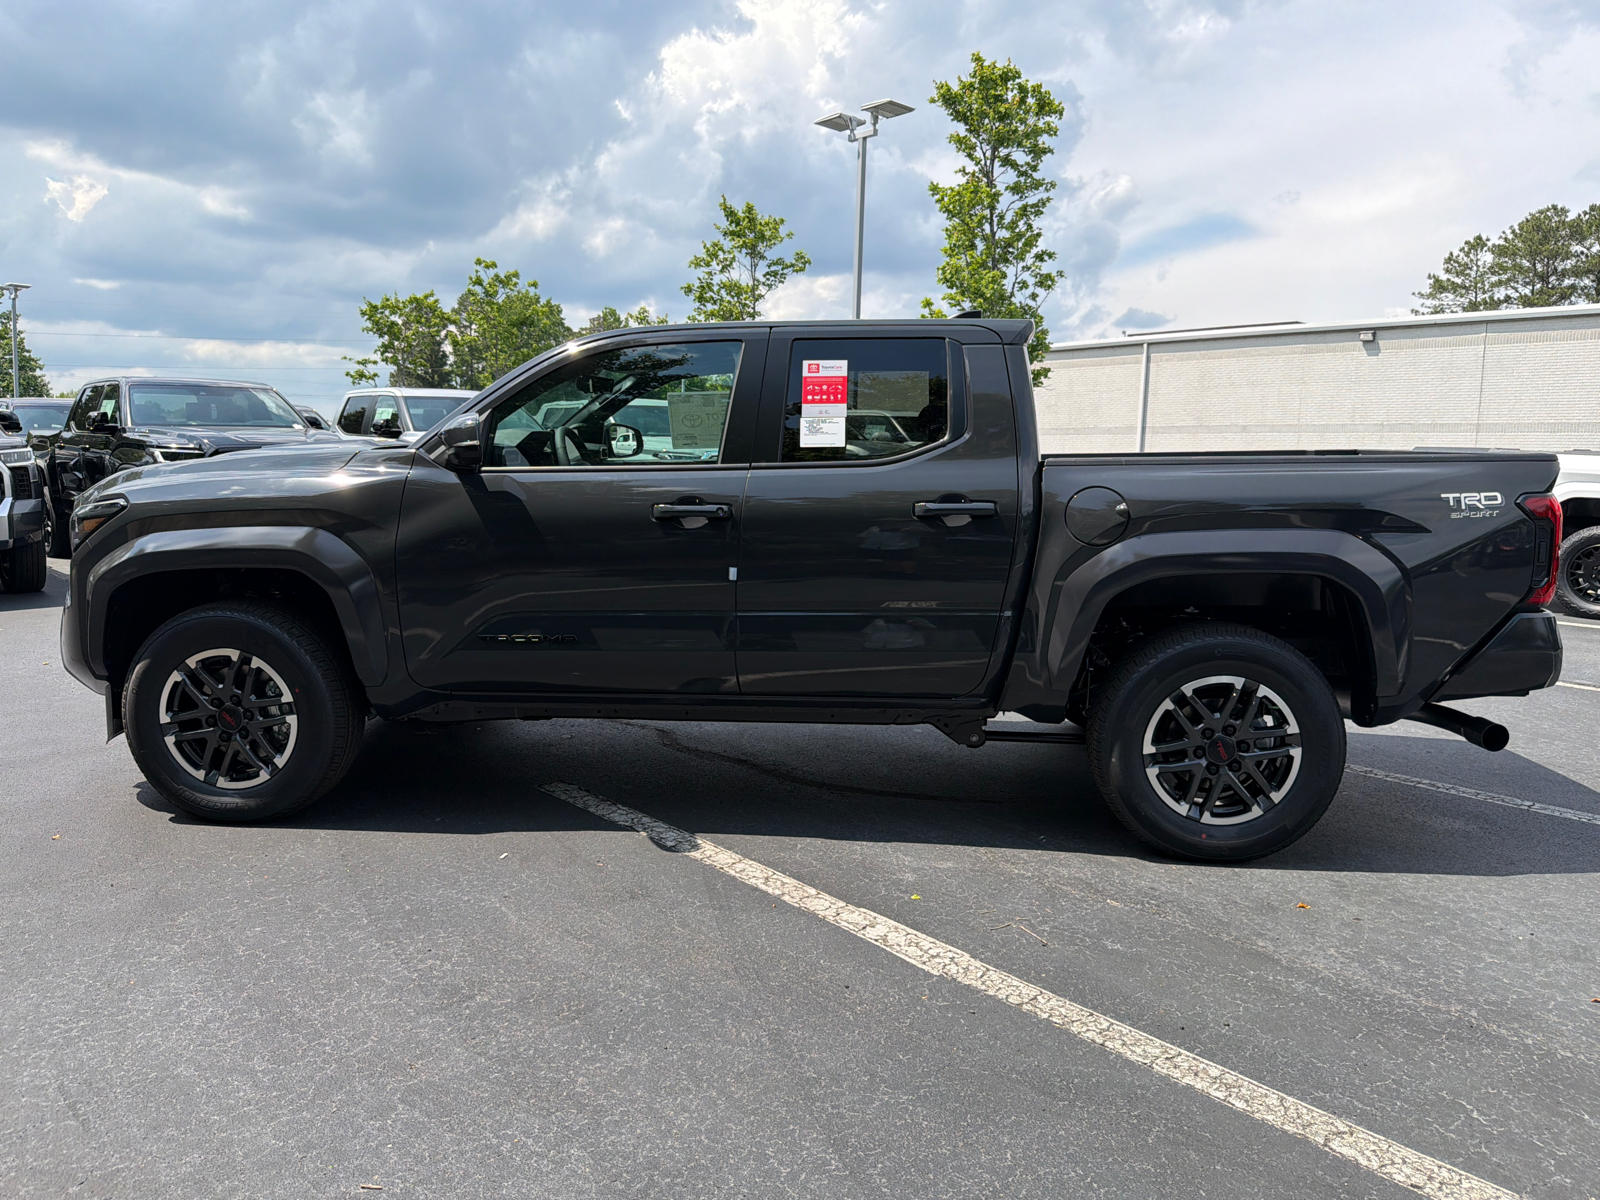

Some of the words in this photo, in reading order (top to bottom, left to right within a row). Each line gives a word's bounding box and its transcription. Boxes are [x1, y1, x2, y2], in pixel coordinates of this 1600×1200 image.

[1440, 492, 1503, 510] TRD
[1450, 510, 1500, 519] SPORT
[478, 634, 578, 643] TACOMA
[1216, 740, 1228, 761] TRD
